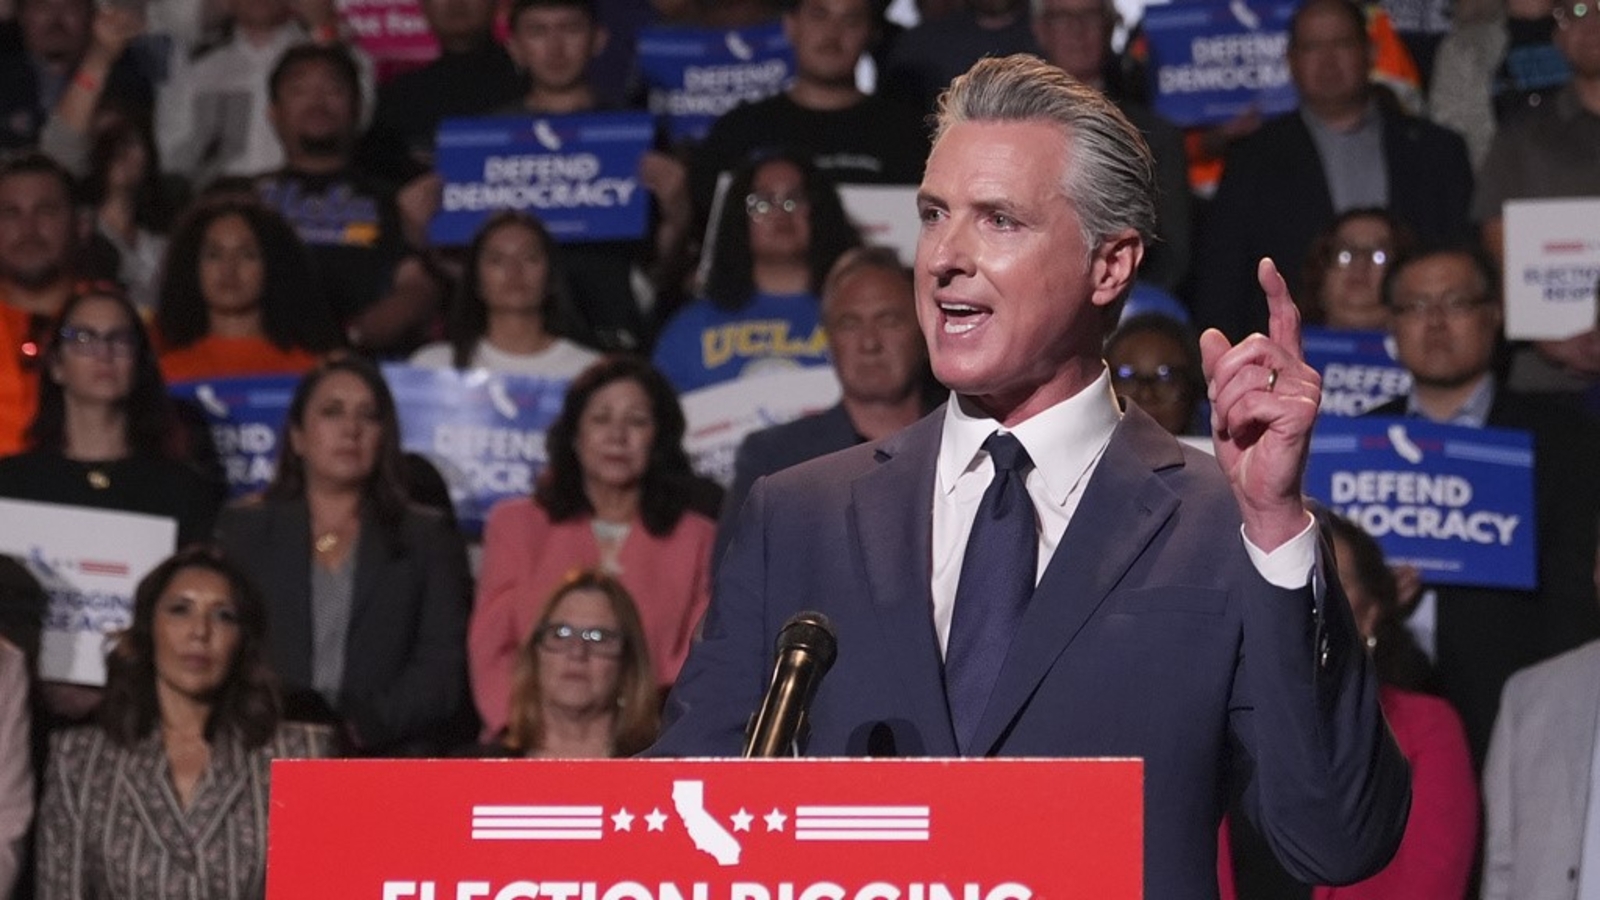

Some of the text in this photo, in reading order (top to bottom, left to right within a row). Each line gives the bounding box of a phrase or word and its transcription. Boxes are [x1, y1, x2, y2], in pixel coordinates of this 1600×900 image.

[1191, 33, 1288, 63] DEFEN
[683, 59, 787, 91] DEFEND
[1158, 63, 1291, 93] DEMOCRA
[485, 153, 599, 183] DEFEND
[442, 177, 636, 211] DEMOCRACY
[434, 425, 549, 462] DEFEN
[1331, 471, 1473, 507] DEFEND
[1348, 504, 1520, 546] OCRACY
